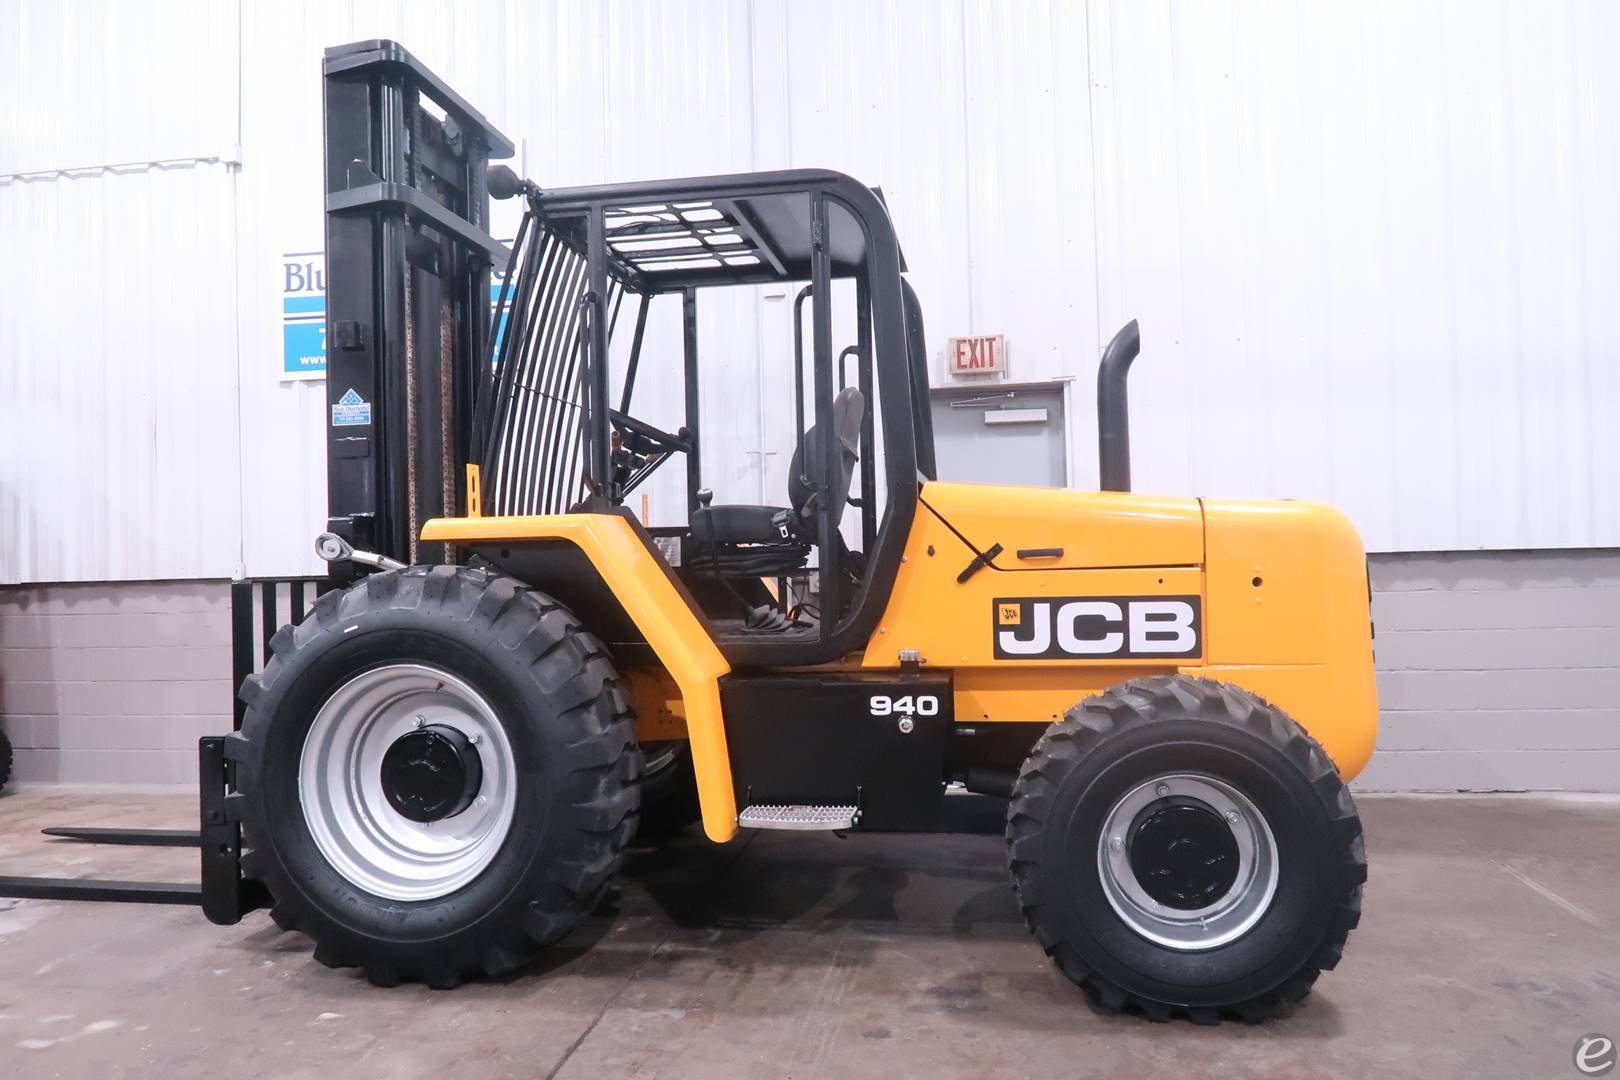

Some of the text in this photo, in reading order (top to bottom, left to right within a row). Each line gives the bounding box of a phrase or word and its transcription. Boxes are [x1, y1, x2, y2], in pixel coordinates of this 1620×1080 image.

[956, 337, 996, 369] EXIT
[999, 601, 1196, 654] JCB
[870, 695, 939, 716] 940
